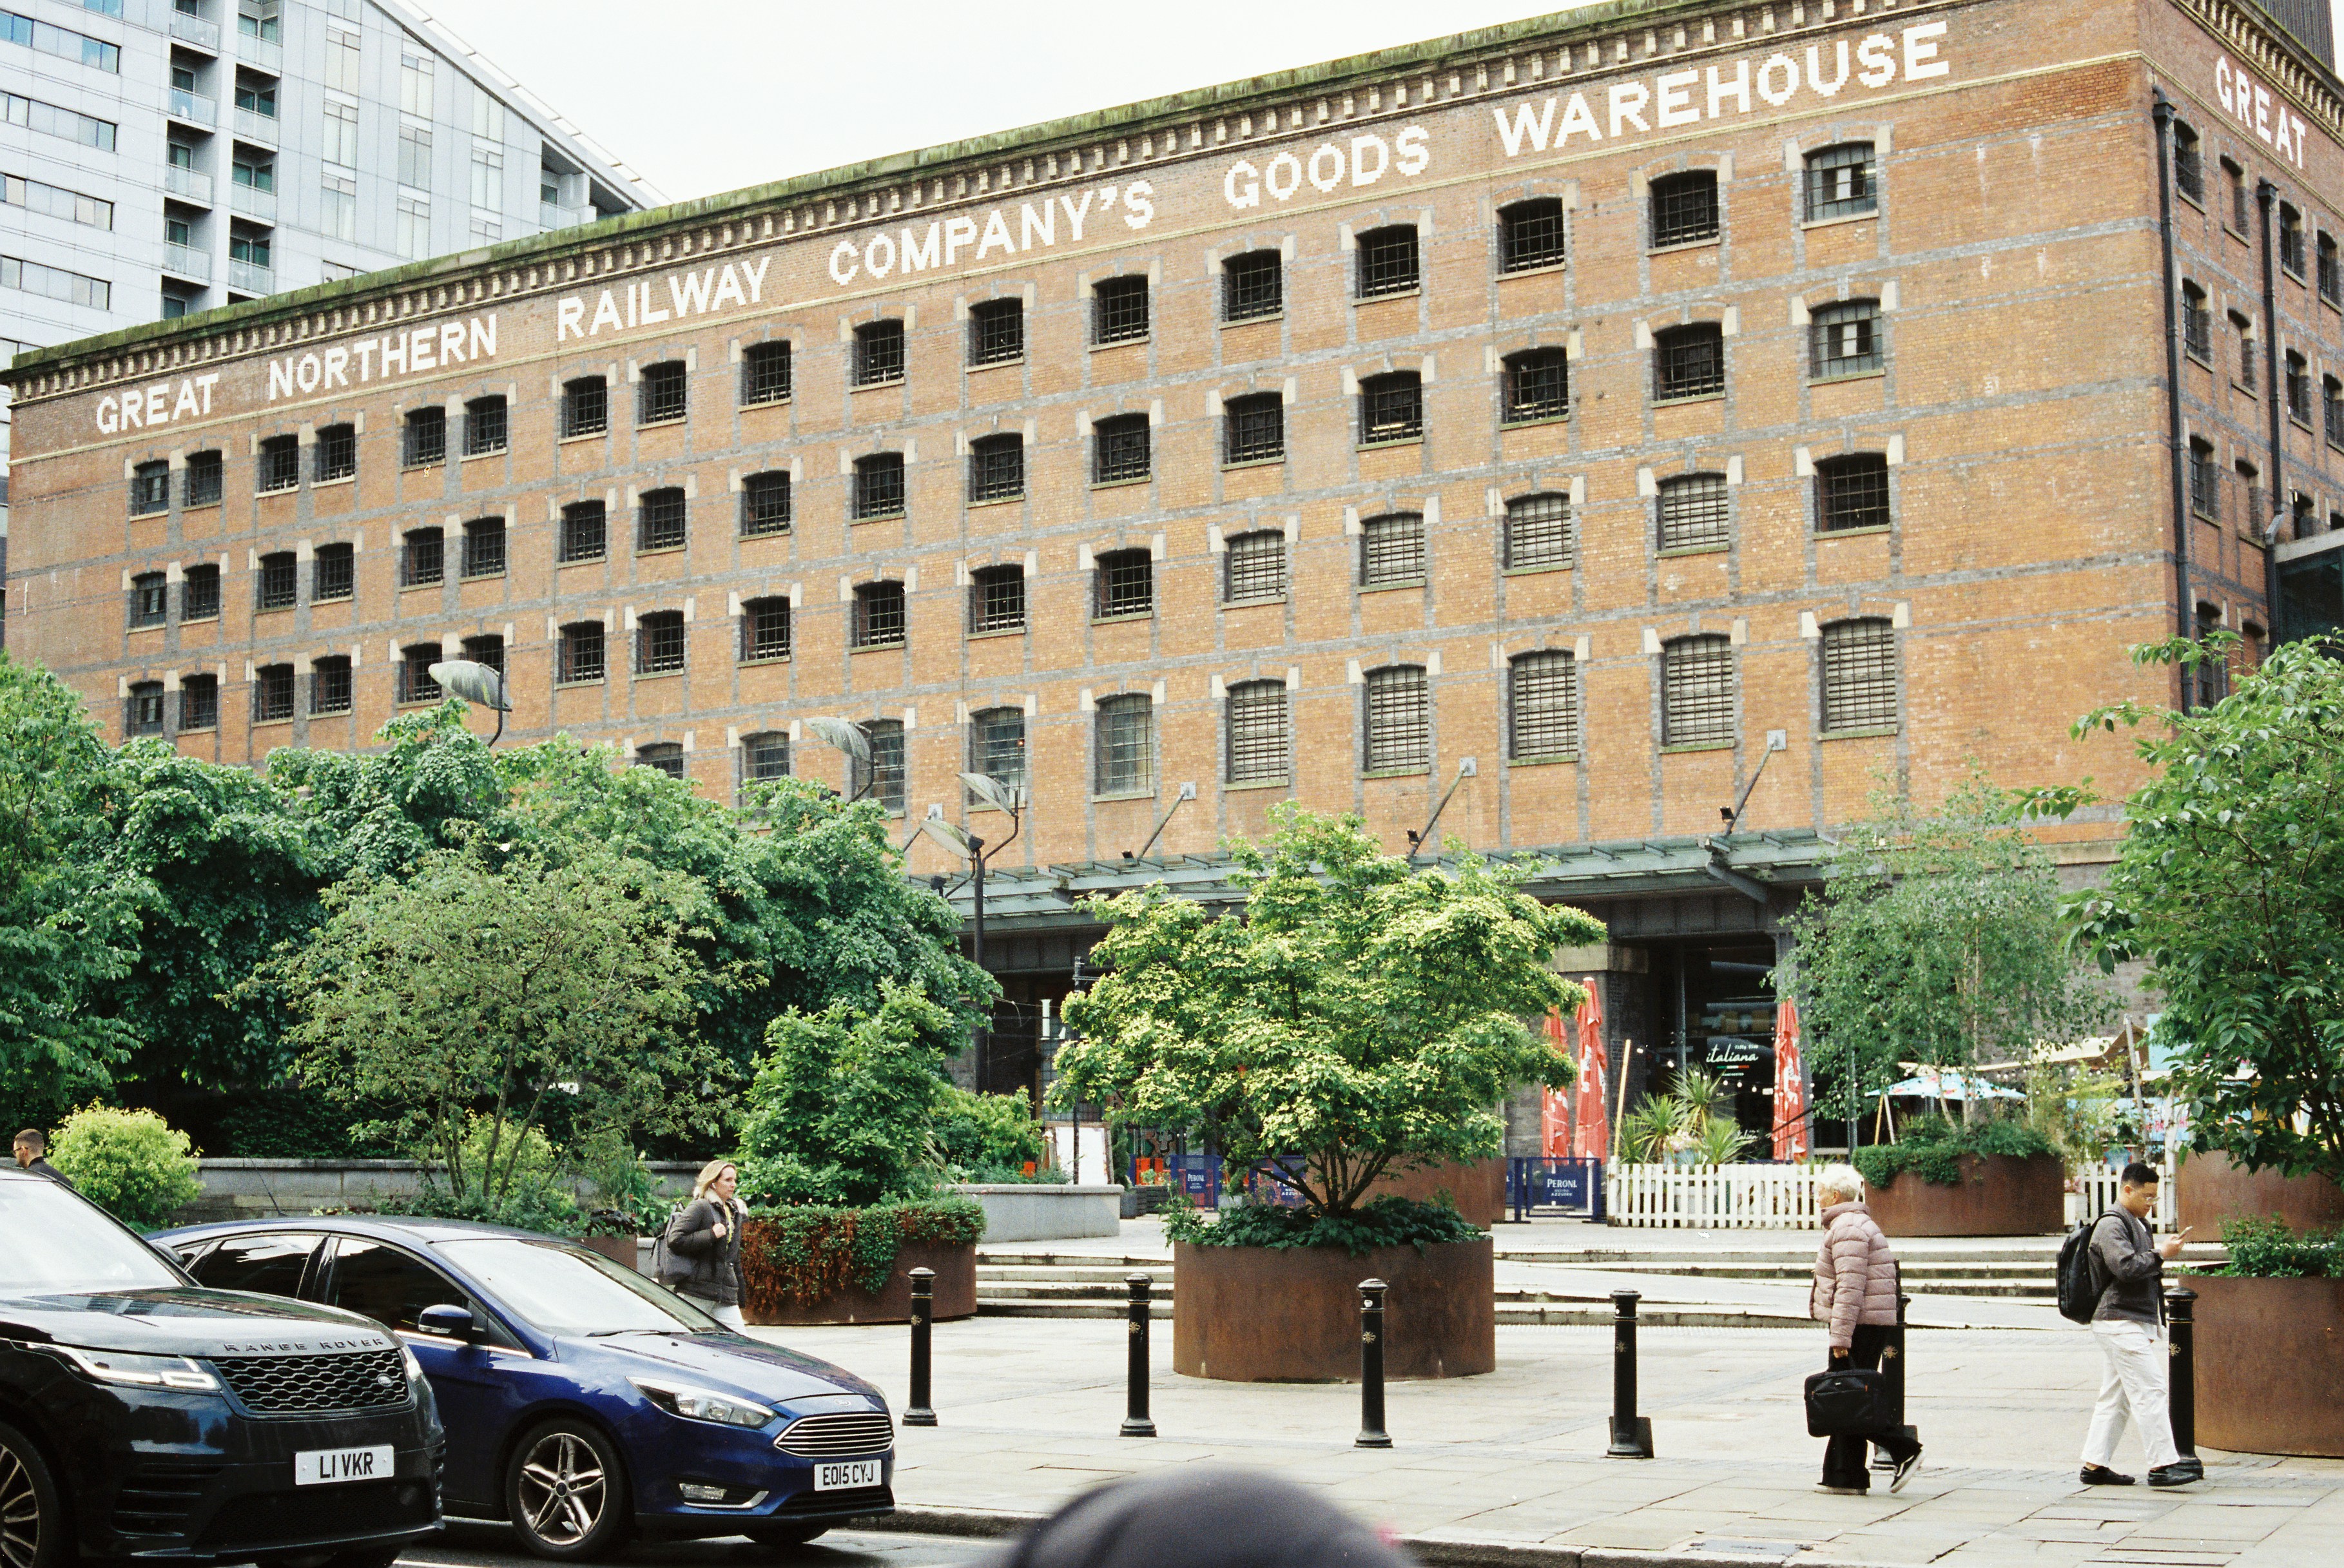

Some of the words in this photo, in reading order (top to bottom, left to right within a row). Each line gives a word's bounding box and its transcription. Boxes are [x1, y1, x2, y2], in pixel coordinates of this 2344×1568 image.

[2216, 55, 2306, 169] GREAT
[97, 373, 218, 433] GREAT
[269, 314, 496, 400] NORTHERN
[558, 256, 770, 341] RAILWAY
[829, 180, 1154, 285] COMPANY'S
[1225, 126, 1429, 209] GOODS
[1494, 21, 1949, 156] WAREHOUSE
[1705, 1043, 1759, 1063] italiana
[223, 1342, 307, 1352] RANGE
[319, 1338, 384, 1350] ROVER
[342, 1451, 373, 1476] VKR
